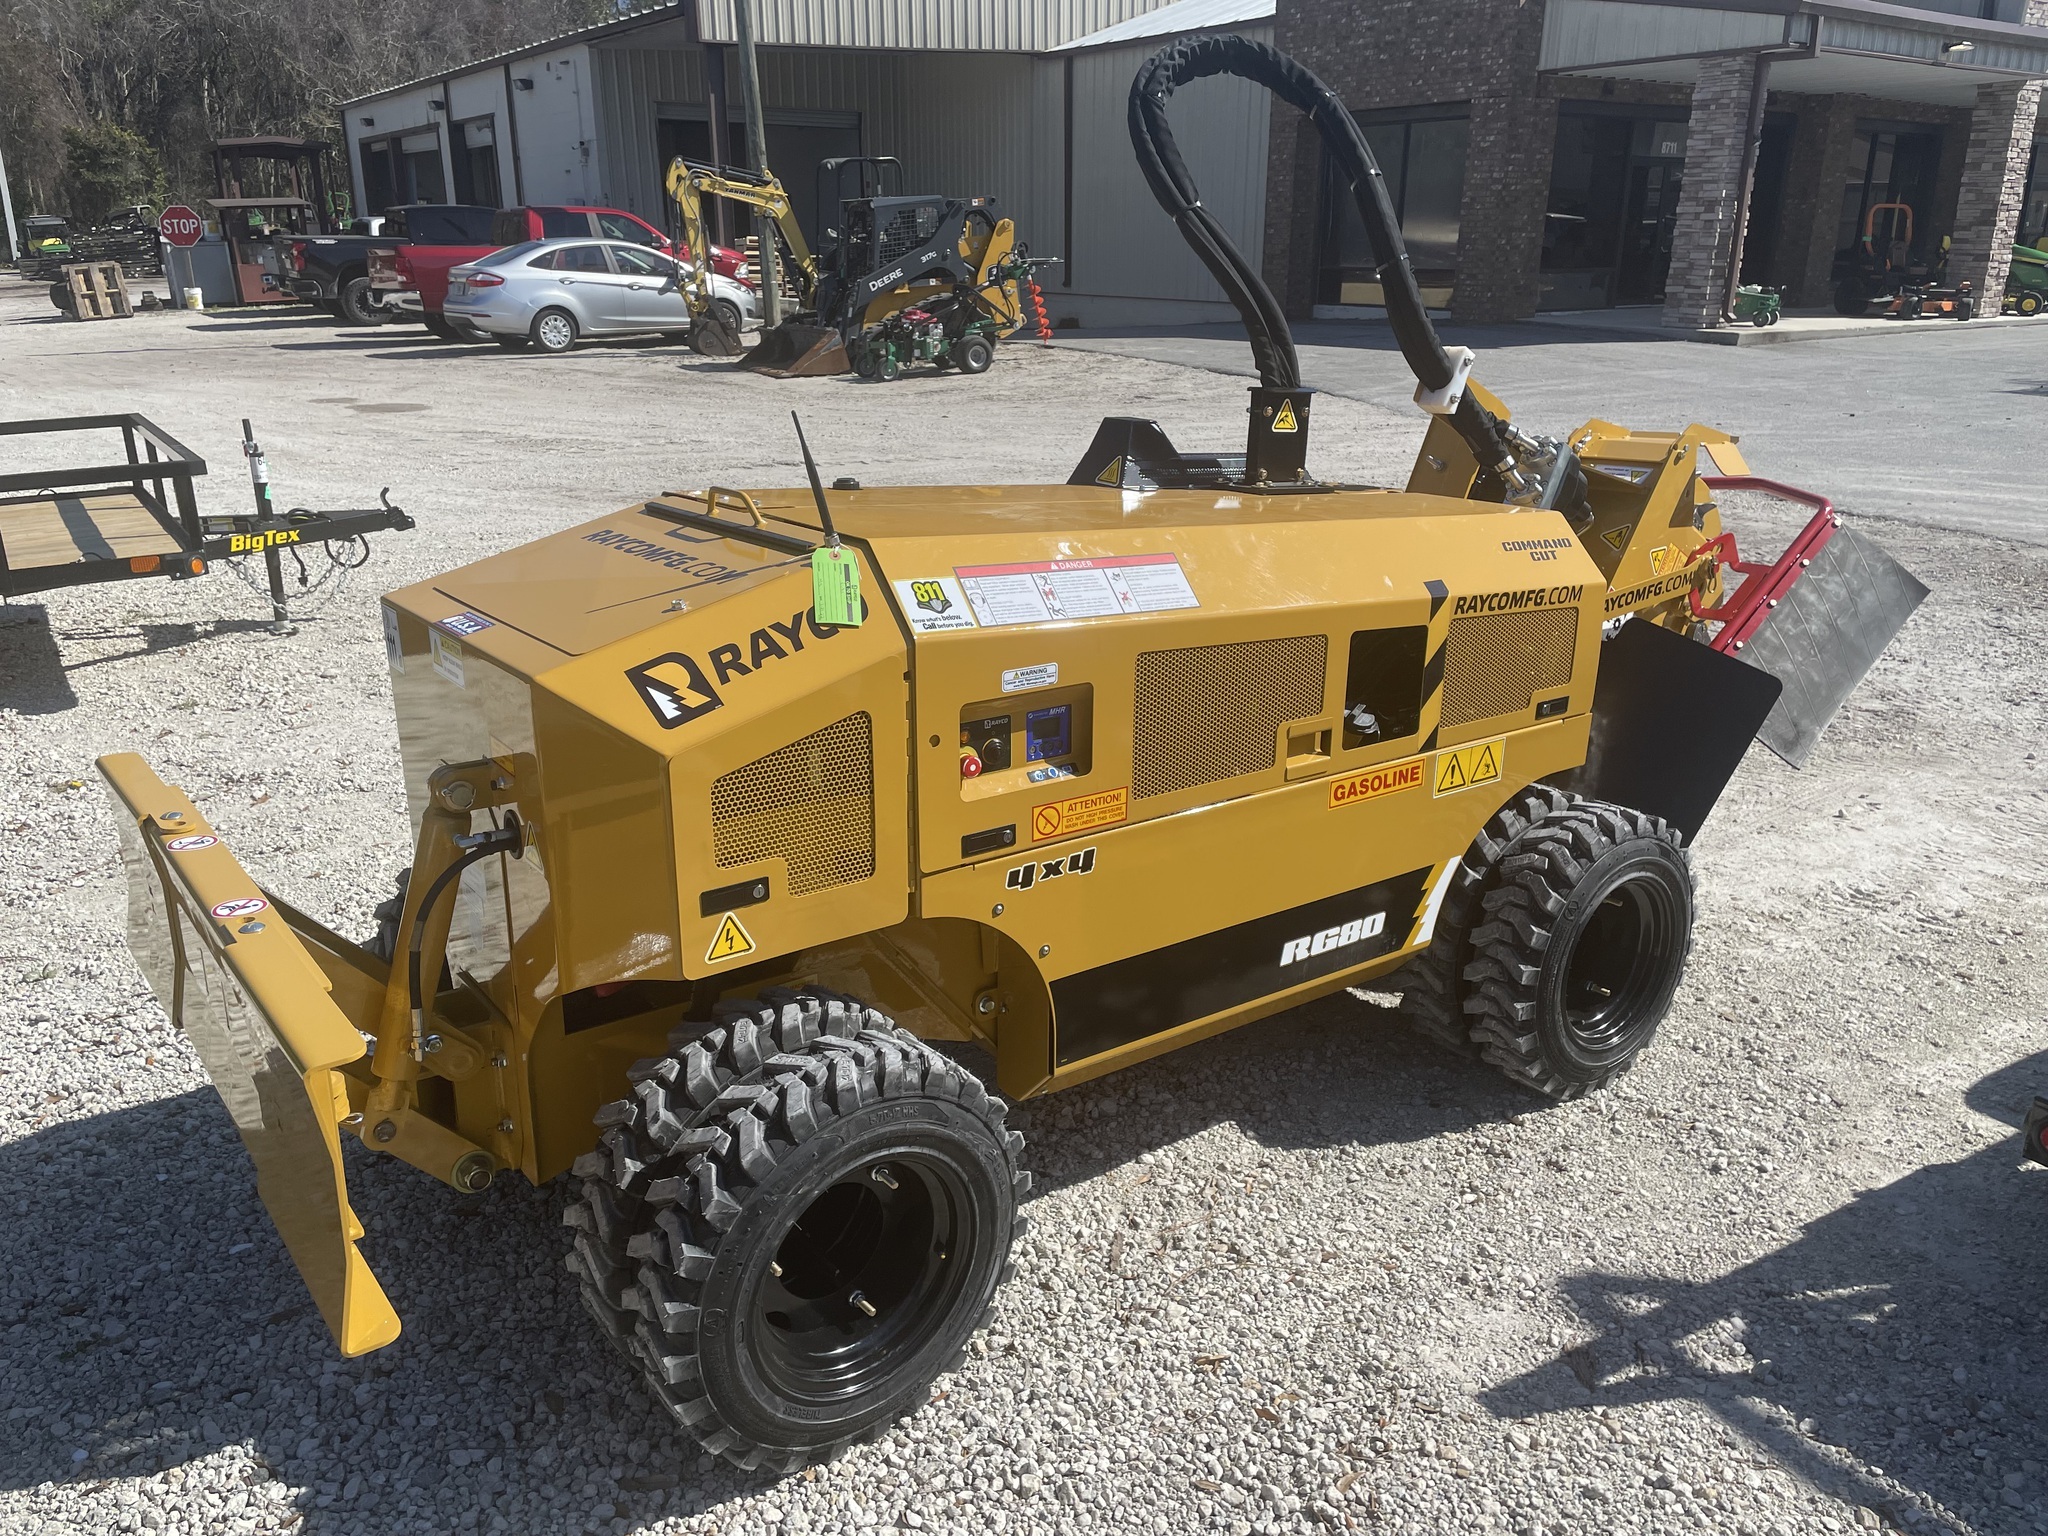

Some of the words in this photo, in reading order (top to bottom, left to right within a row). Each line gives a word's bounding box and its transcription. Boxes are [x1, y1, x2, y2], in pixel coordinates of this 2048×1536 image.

[1661, 141, 1677, 154] 8711
[163, 219, 198, 234] STOP
[920, 251, 937, 263] 317G
[868, 267, 904, 292] DEERE
[230, 529, 300, 552] BigTex
[1501, 537, 1572, 552] COMMAND
[581, 529, 748, 585] RAYCOMFG.COM
[1529, 550, 1558, 562] CUT
[1060, 560, 1093, 569] DANGER
[911, 581, 946, 603] 811
[1454, 584, 1584, 615] RAYCOMFG.COM
[1604, 571, 1694, 613] AYCOMFG.COM
[922, 622, 937, 630] Call
[708, 594, 869, 686] RAYC
[1020, 667, 1047, 677] WARNING
[1049, 706, 1066, 716] MHR
[991, 717, 1009, 726] RAYCO
[1333, 765, 1421, 802] GASOLINE
[1067, 792, 1122, 813] ATTENTION!
[1080, 818, 1096, 826] UNDER
[1109, 811, 1125, 819] COVER
[1099, 806, 1123, 816] PRESSURE
[1005, 846, 1097, 892] 4x4
[1279, 910, 1387, 968] RG80
